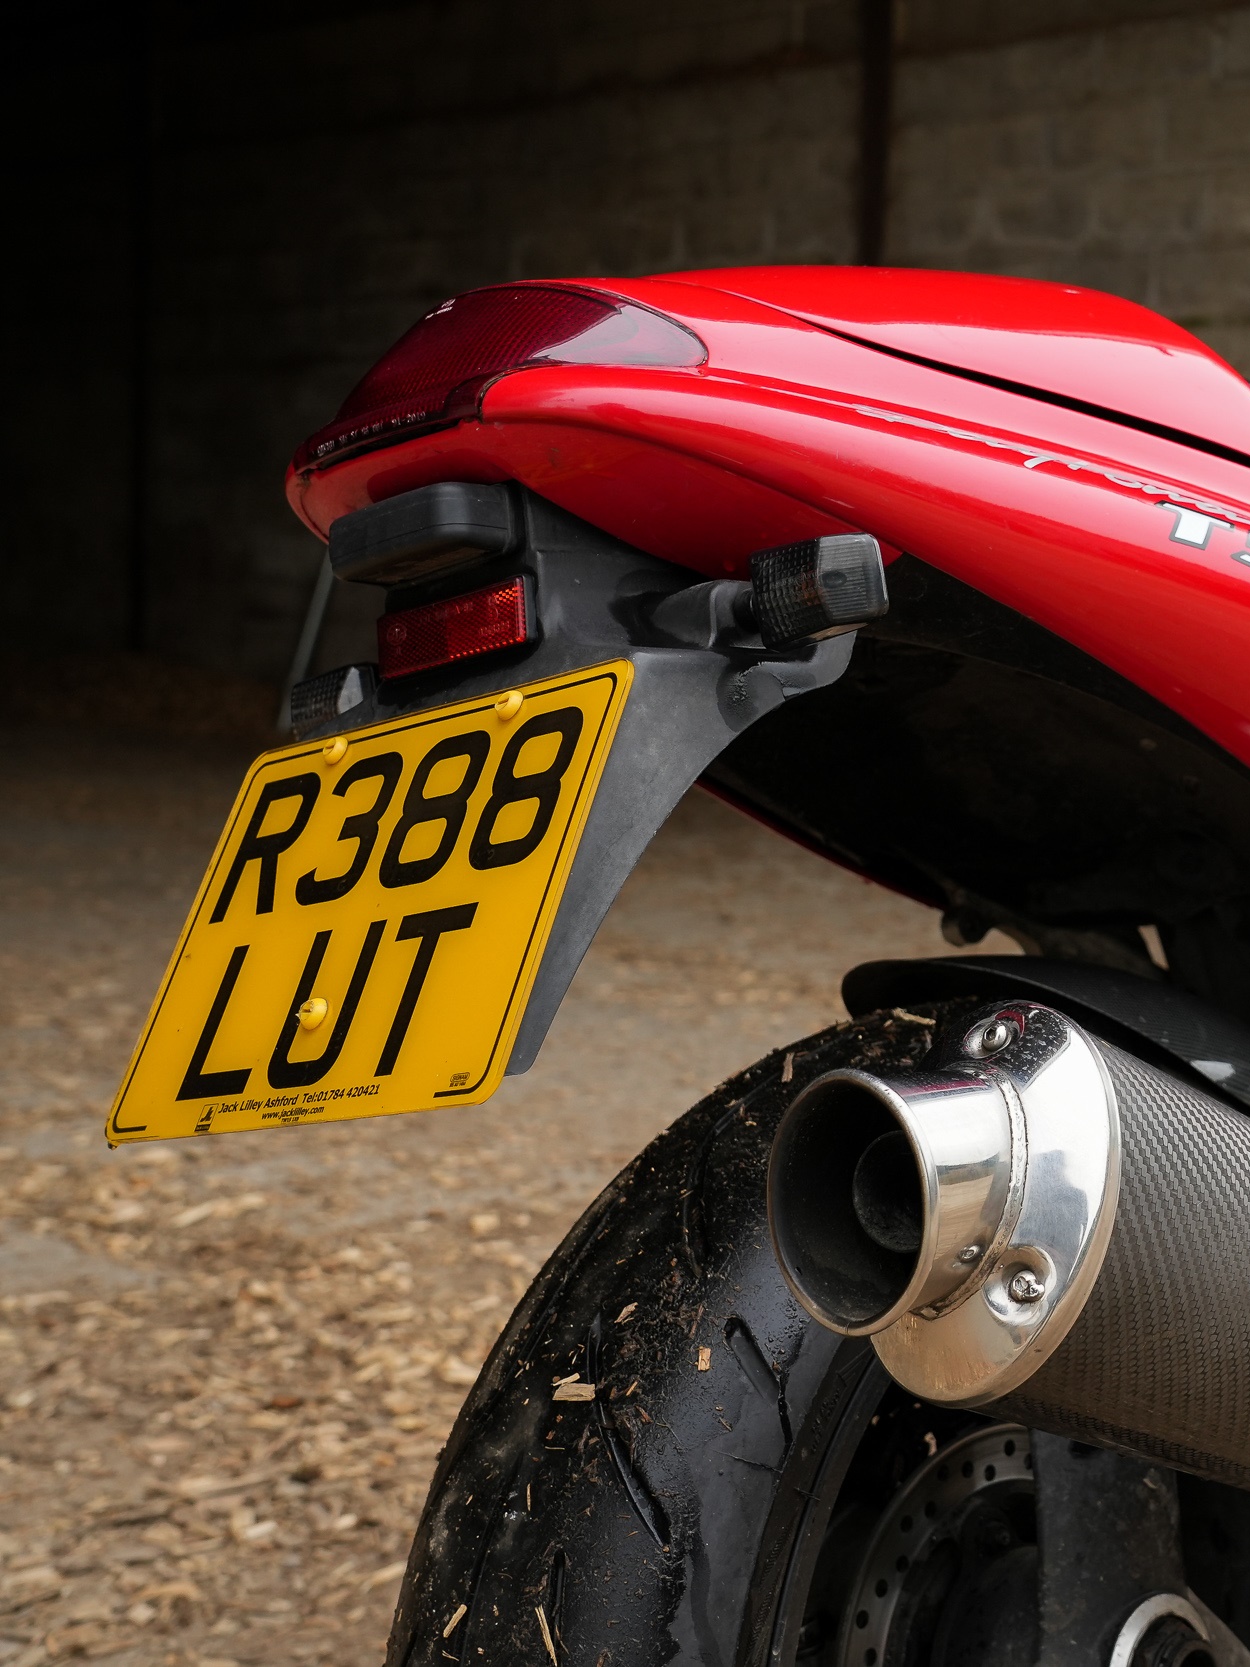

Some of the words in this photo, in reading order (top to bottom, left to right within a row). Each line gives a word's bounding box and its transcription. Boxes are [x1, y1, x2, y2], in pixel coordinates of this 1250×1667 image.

[209, 706, 585, 925] R388
[175, 902, 479, 1102] LUT
[218, 1101, 239, 1114] Jack
[239, 1099, 264, 1112] Lilley
[263, 1094, 300, 1109] Ashford
[302, 1088, 346, 1104] Tel:01784
[346, 1084, 381, 1099] 420421
